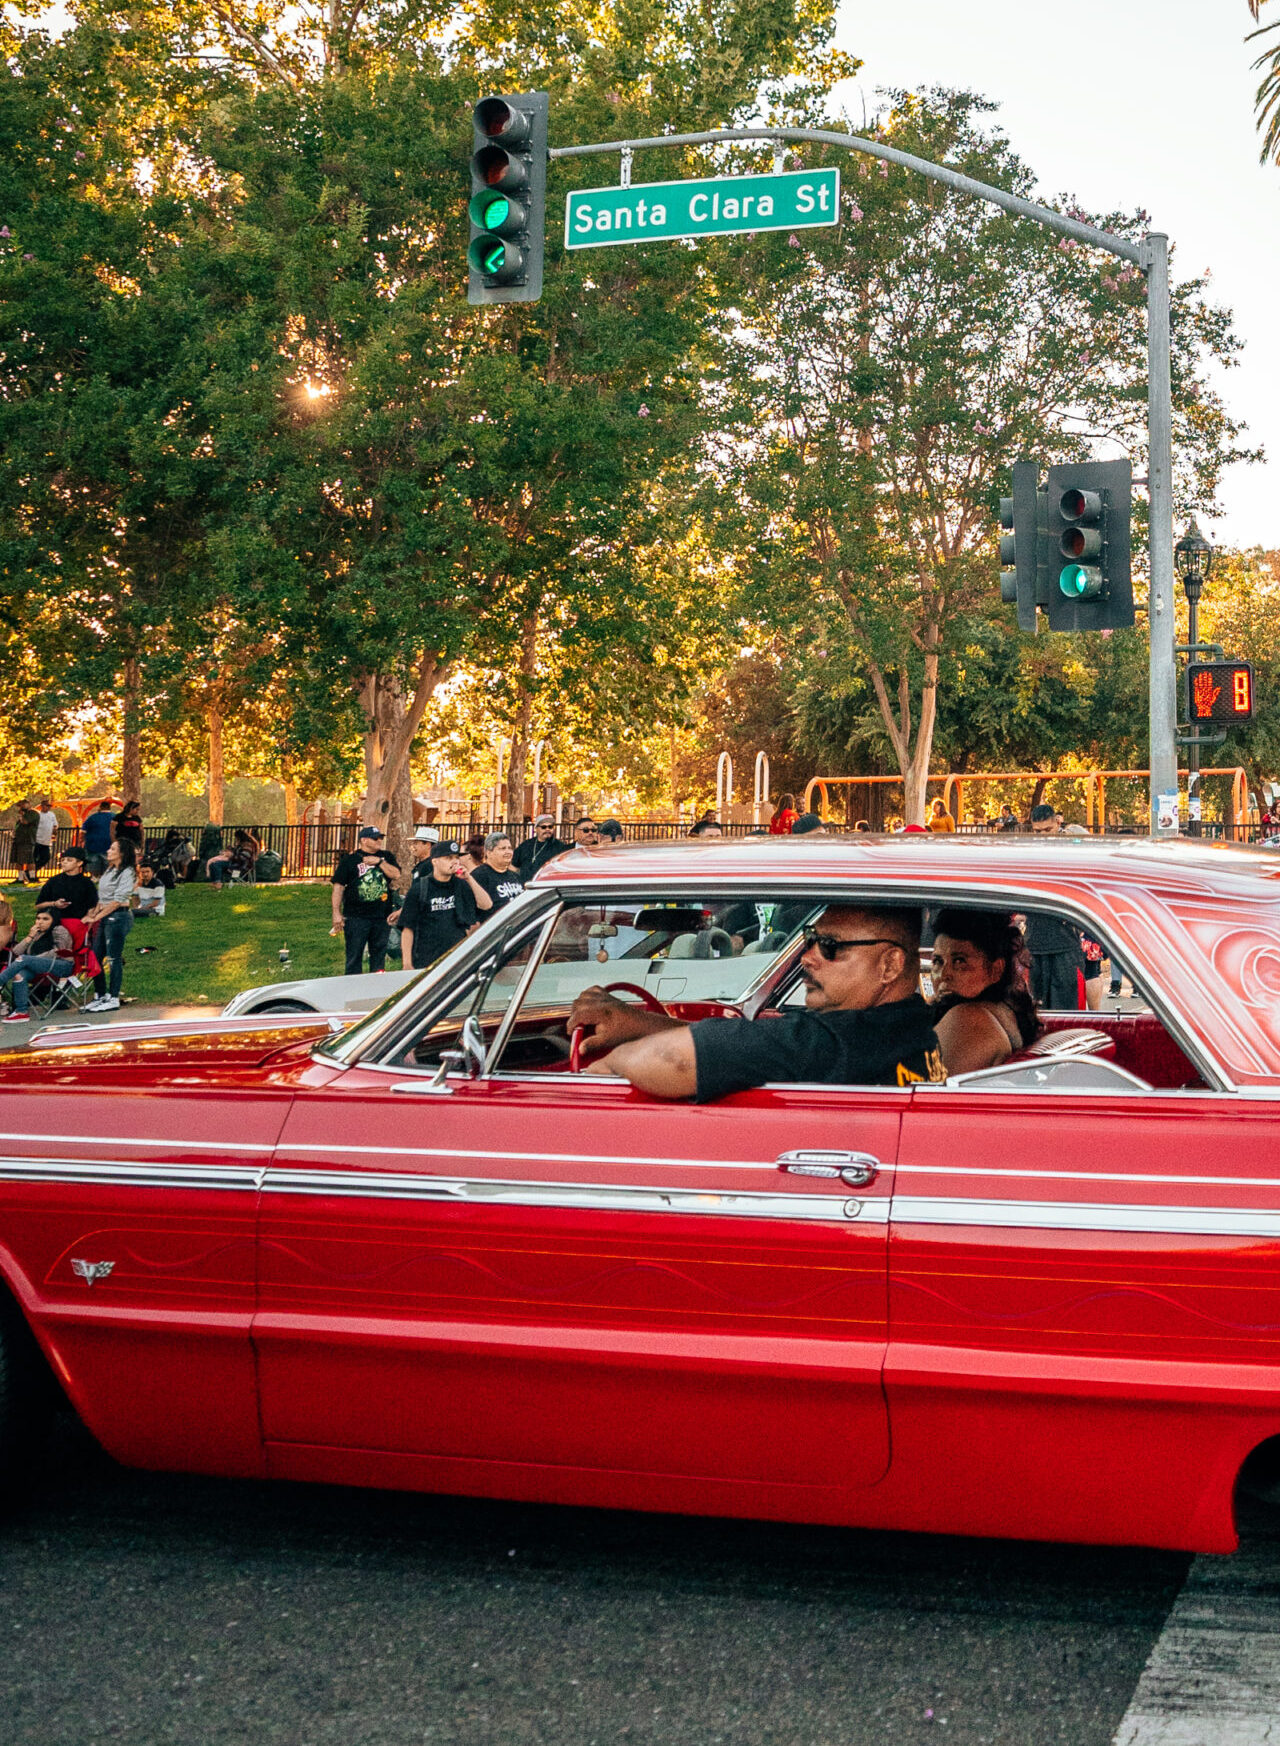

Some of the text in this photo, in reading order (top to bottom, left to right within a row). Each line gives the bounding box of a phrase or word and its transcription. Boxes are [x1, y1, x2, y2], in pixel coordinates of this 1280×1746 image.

[574, 183, 830, 233] Santa Clara St
[1234, 671, 1249, 711] 8
